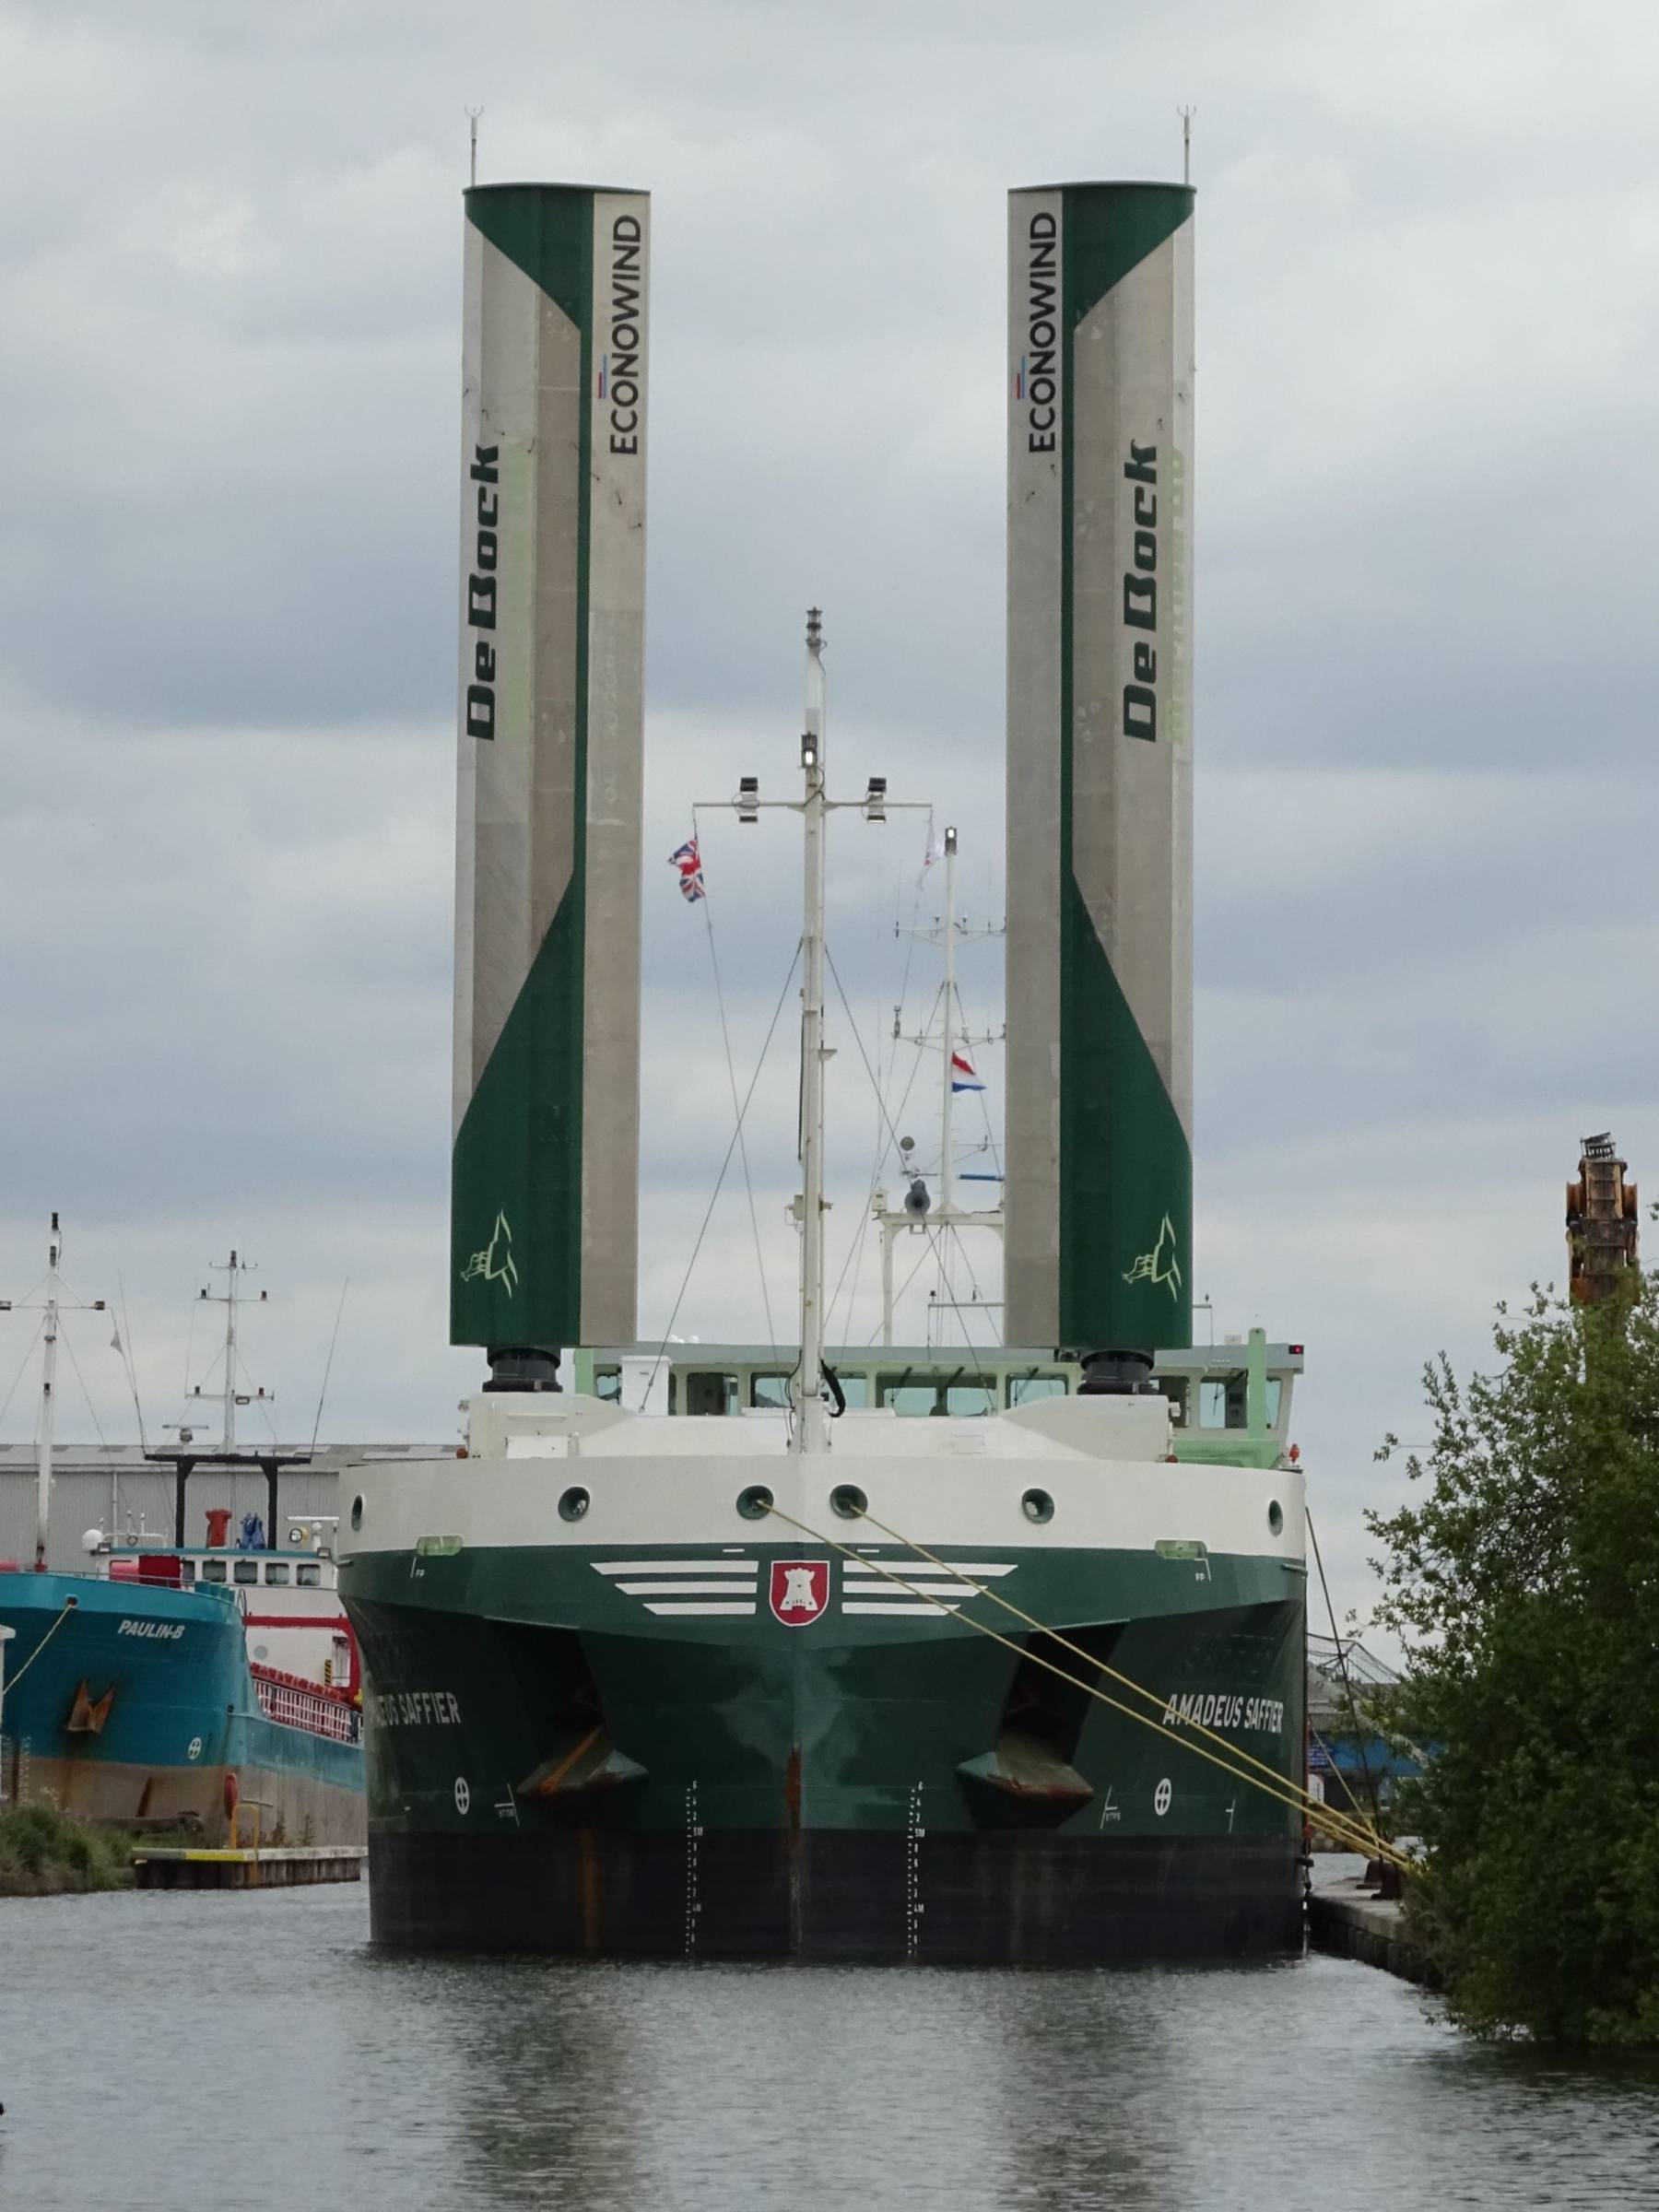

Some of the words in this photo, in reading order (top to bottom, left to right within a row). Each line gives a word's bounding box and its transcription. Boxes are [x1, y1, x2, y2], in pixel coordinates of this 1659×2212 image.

[609, 215, 641, 455] ECONOWIND
[1029, 212, 1057, 453] ECONOWIND
[467, 443, 499, 630] Bock
[1123, 439, 1157, 632] Bock
[466, 641, 496, 741] De
[1123, 641, 1157, 743] De
[117, 1619, 186, 1639] PAULIN-B
[398, 1691, 461, 1725] SAFFIER
[1162, 1693, 1243, 1728] AMADEUS
[1243, 1697, 1284, 1734] SAFFIER
